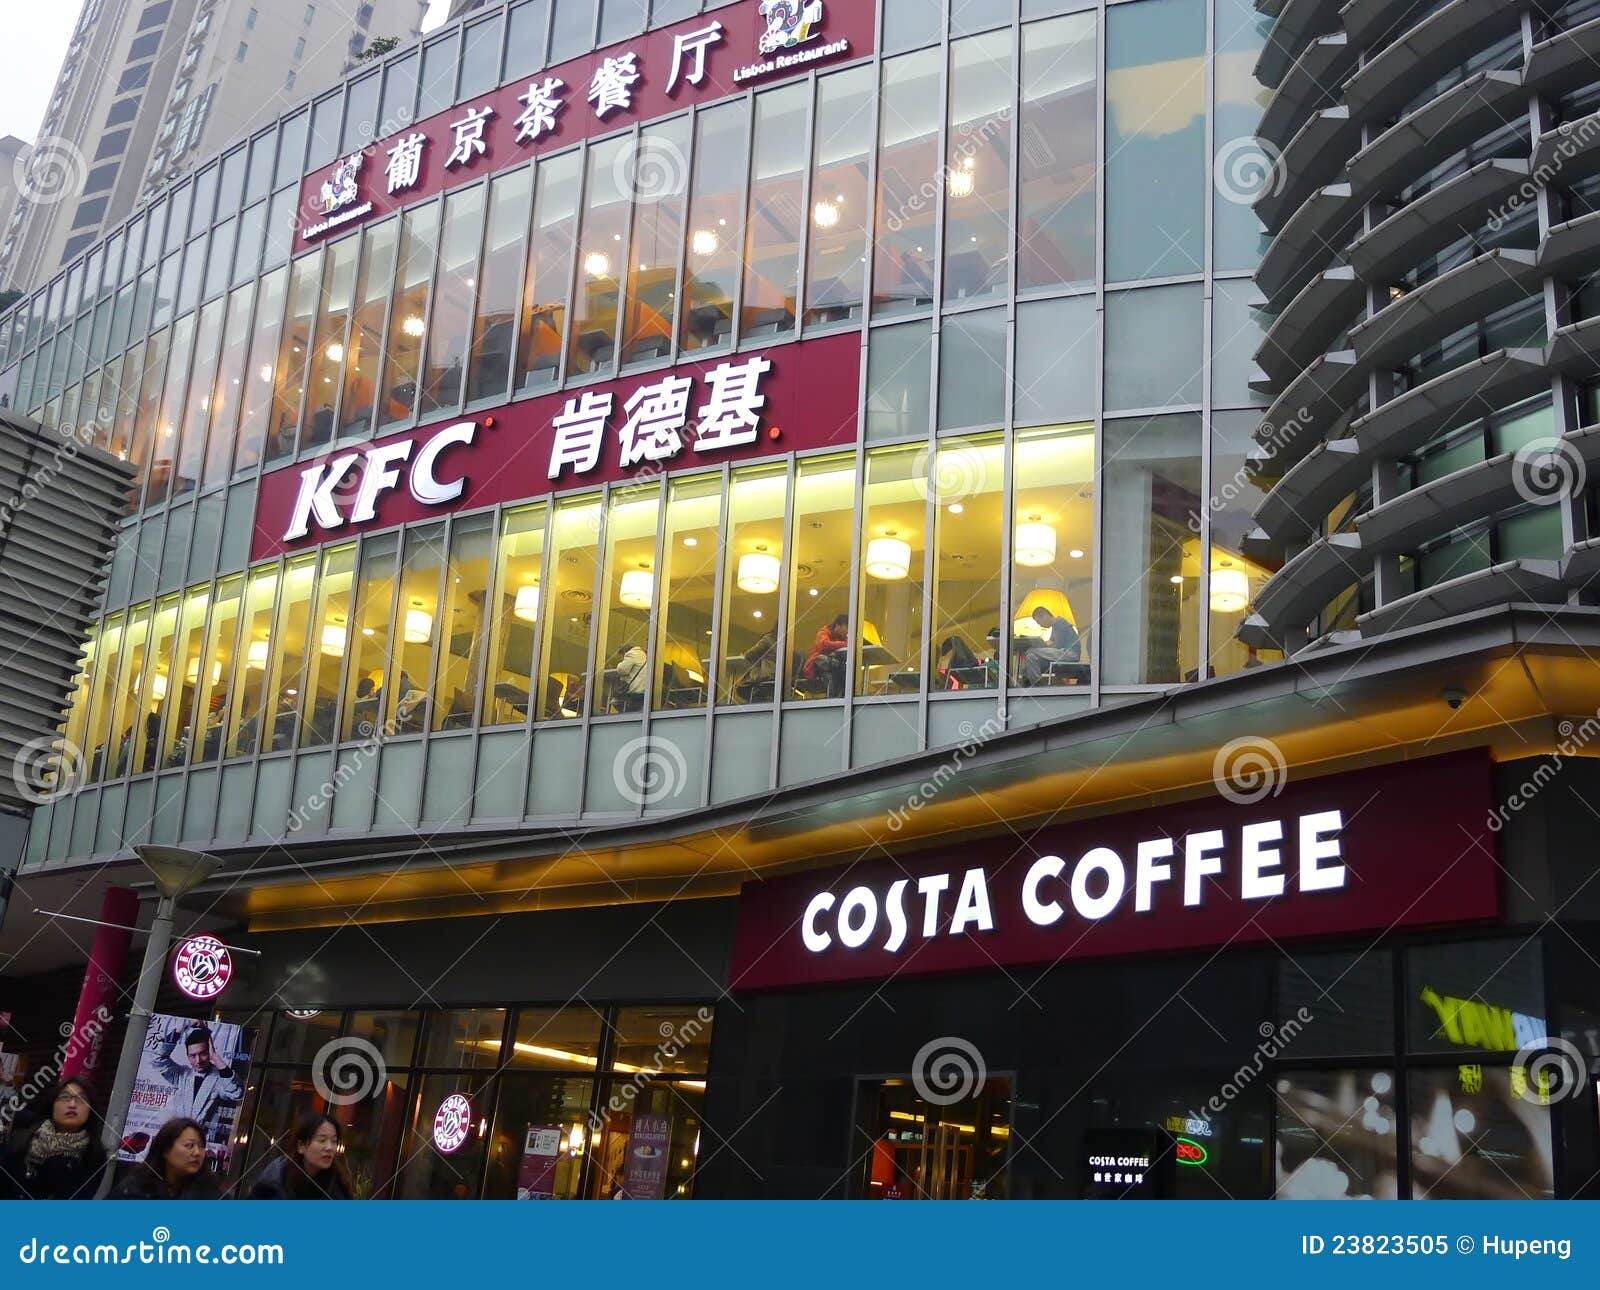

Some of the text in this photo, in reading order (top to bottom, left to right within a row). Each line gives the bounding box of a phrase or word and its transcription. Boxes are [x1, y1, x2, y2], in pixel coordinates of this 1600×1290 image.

[384, 20, 723, 194] 葡京茶餐厅
[733, 39, 848, 81] Lisboa Restaurant
[547, 356, 771, 479] 肯德基
[283, 421, 478, 542] KFC
[801, 810, 1346, 953] COSTA COFFEE
[178, 967, 224, 994] COFFEE
[1089, 1156, 1150, 1167] COSTA COFFEE
